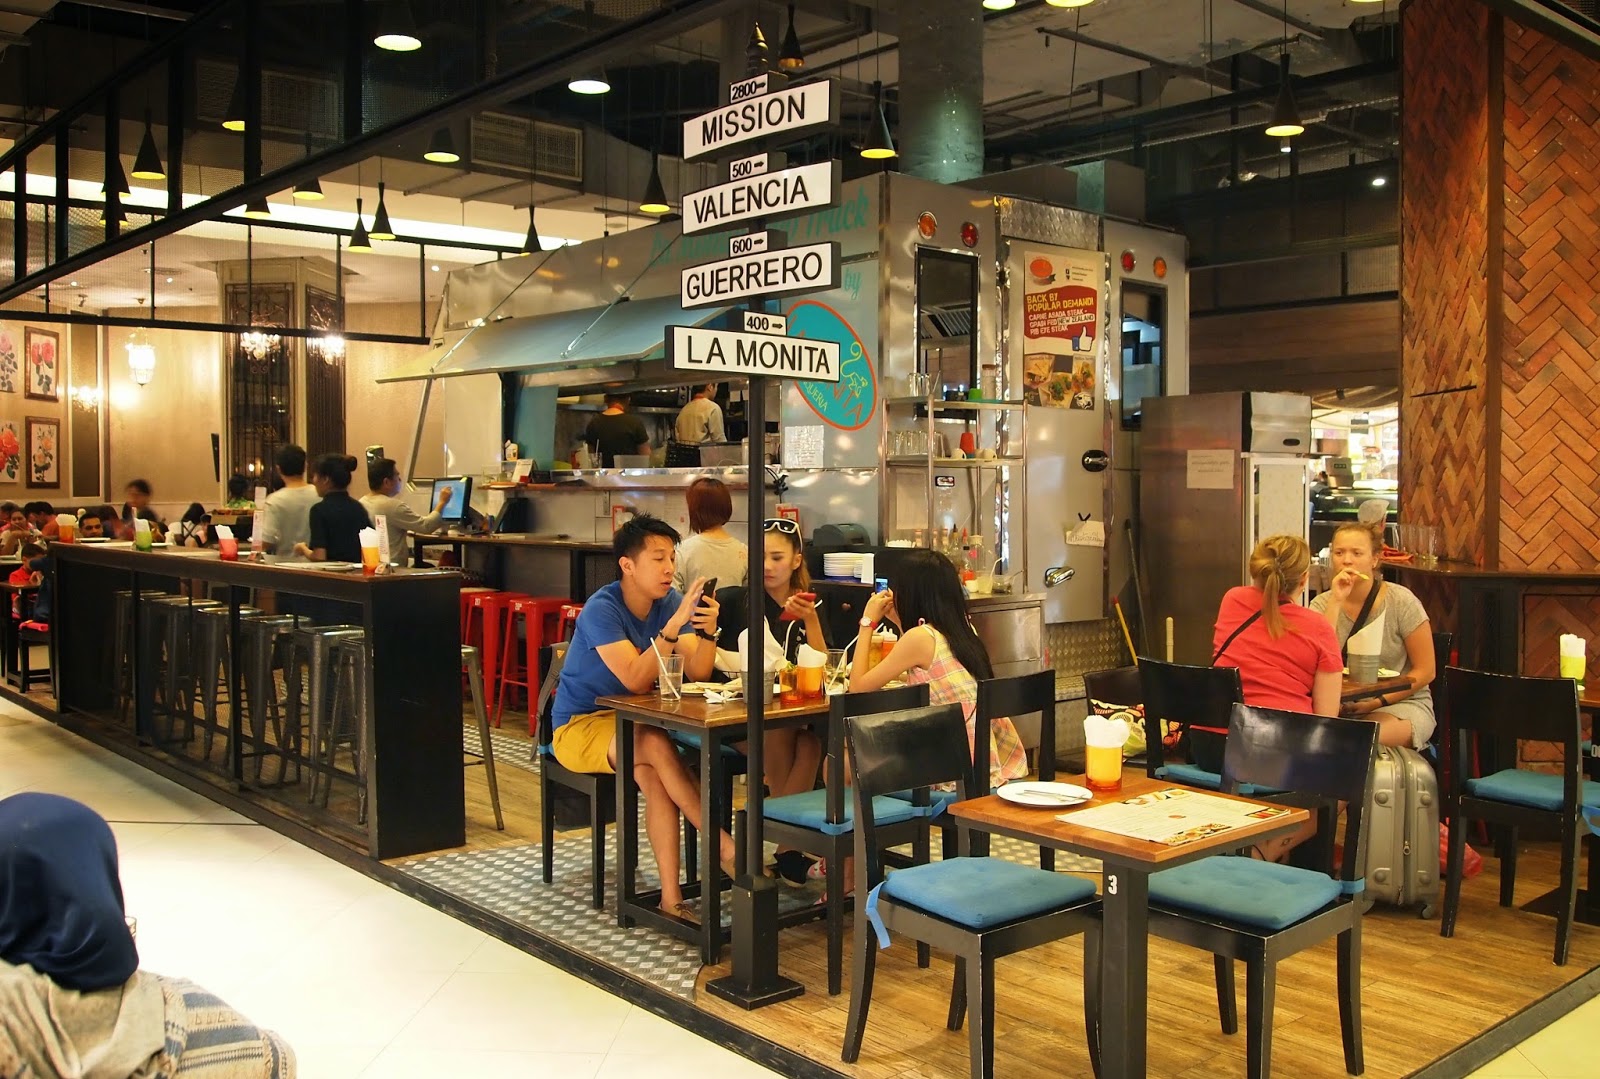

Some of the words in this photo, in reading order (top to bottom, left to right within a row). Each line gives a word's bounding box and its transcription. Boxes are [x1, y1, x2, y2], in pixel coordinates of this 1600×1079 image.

[731, 80, 757, 100] 2800
[702, 92, 806, 146] MISSION
[732, 160, 752, 178] 500
[693, 175, 809, 224] VALENCIA
[732, 237, 752, 254] 600
[686, 251, 823, 300] GUERRERO
[844, 267, 861, 300] by
[1026, 294, 1047, 304] BACK
[1049, 292, 1058, 302] BY
[1027, 301, 1061, 313] POPULAR
[746, 316, 769, 331] 400
[687, 335, 727, 366] LA
[736, 339, 831, 374] MONITA
[1107, 874, 1118, 895] 3
